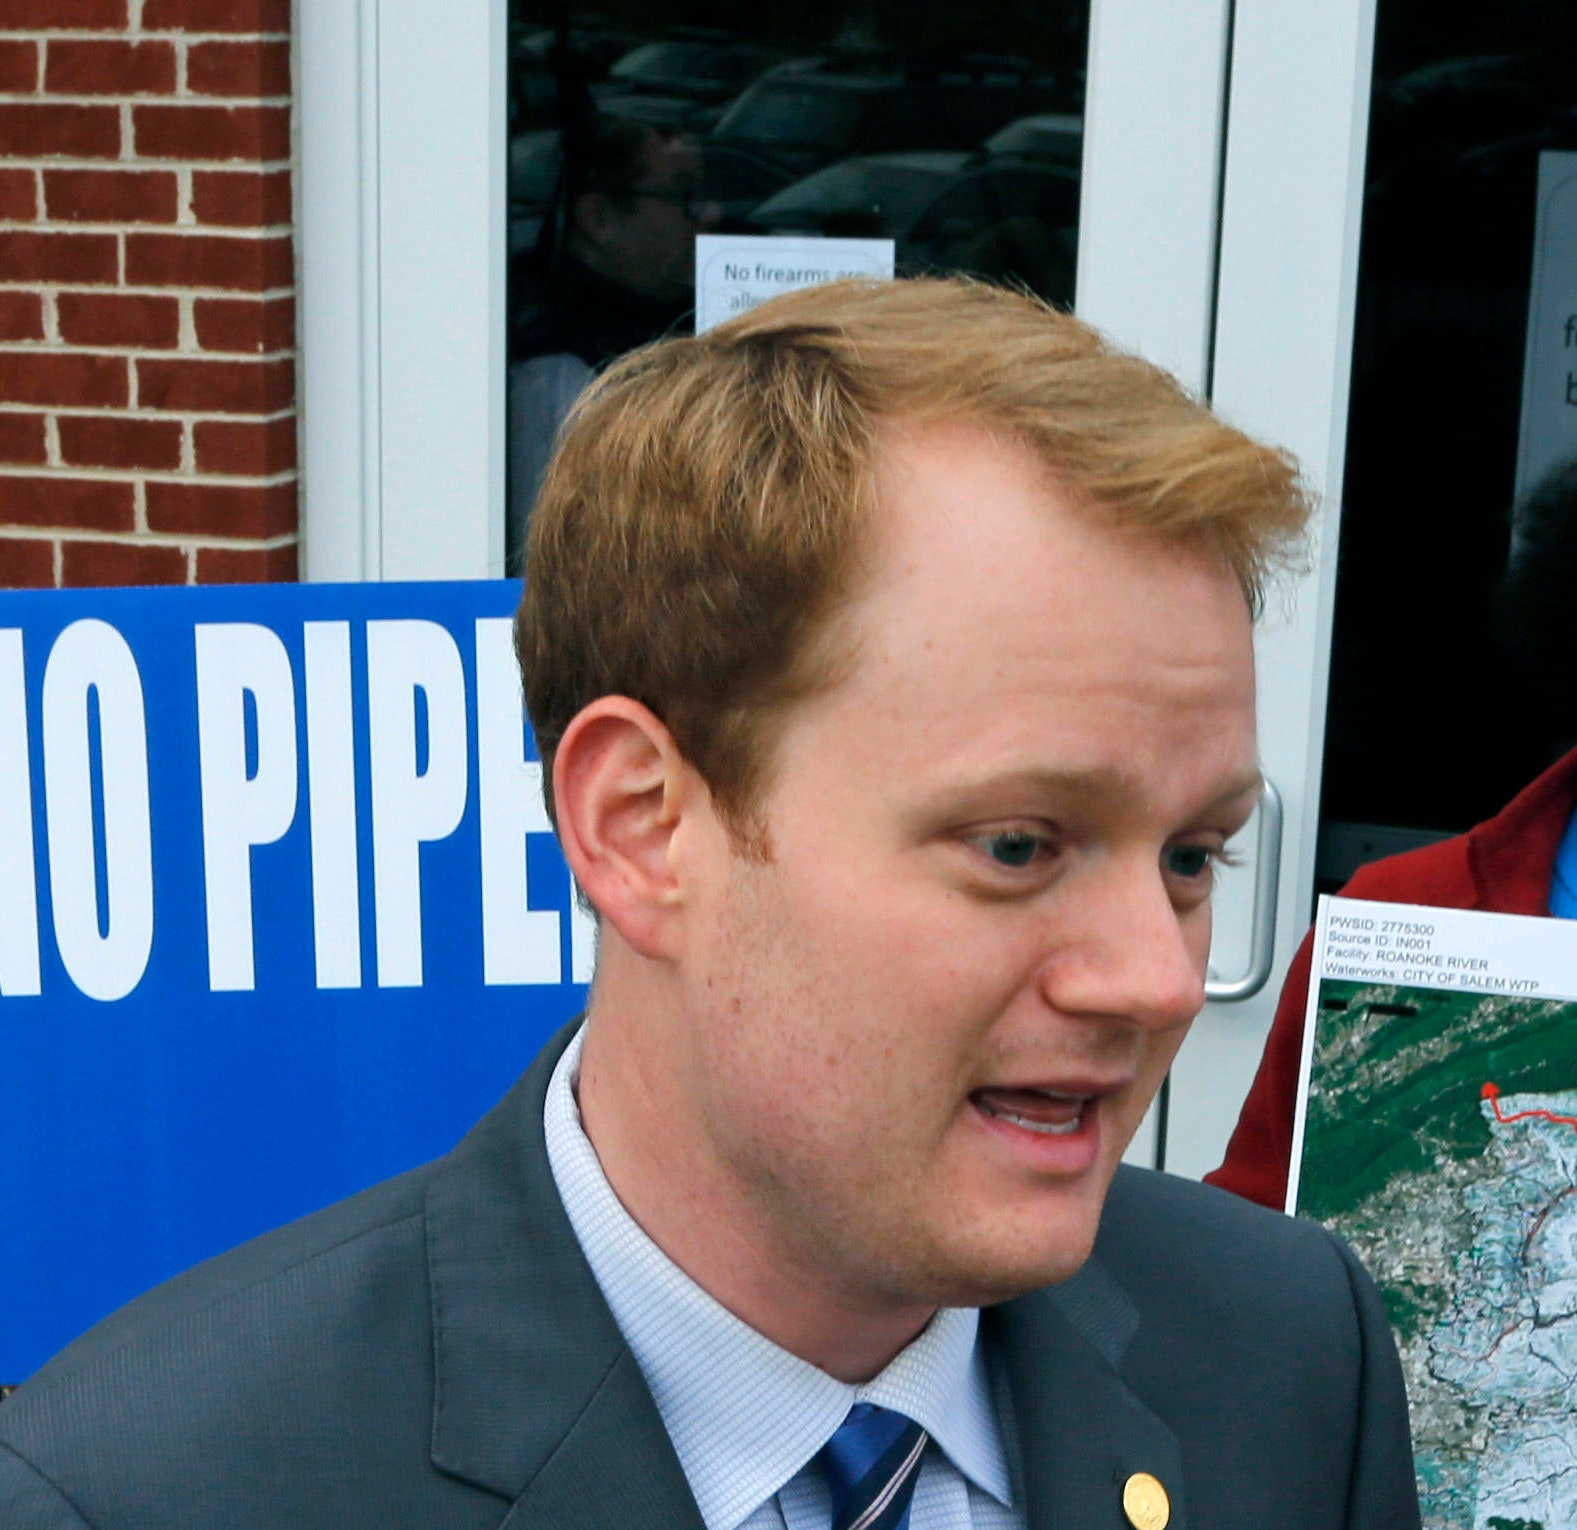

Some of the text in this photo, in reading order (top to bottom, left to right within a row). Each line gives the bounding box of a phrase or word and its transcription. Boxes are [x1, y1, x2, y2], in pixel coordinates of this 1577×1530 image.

[724, 263, 751, 281] No
[755, 263, 831, 282] firearms
[1328, 931, 1372, 946] Source
[1375, 936, 1393, 947] ID:
[1376, 950, 1444, 967] ROANOKE
[1447, 956, 1489, 972] RIVER
[1402, 968, 1435, 983] CITY
[1437, 973, 1456, 985] OF
[1459, 975, 1506, 991] SALEM
[1509, 979, 1540, 993] WTP
